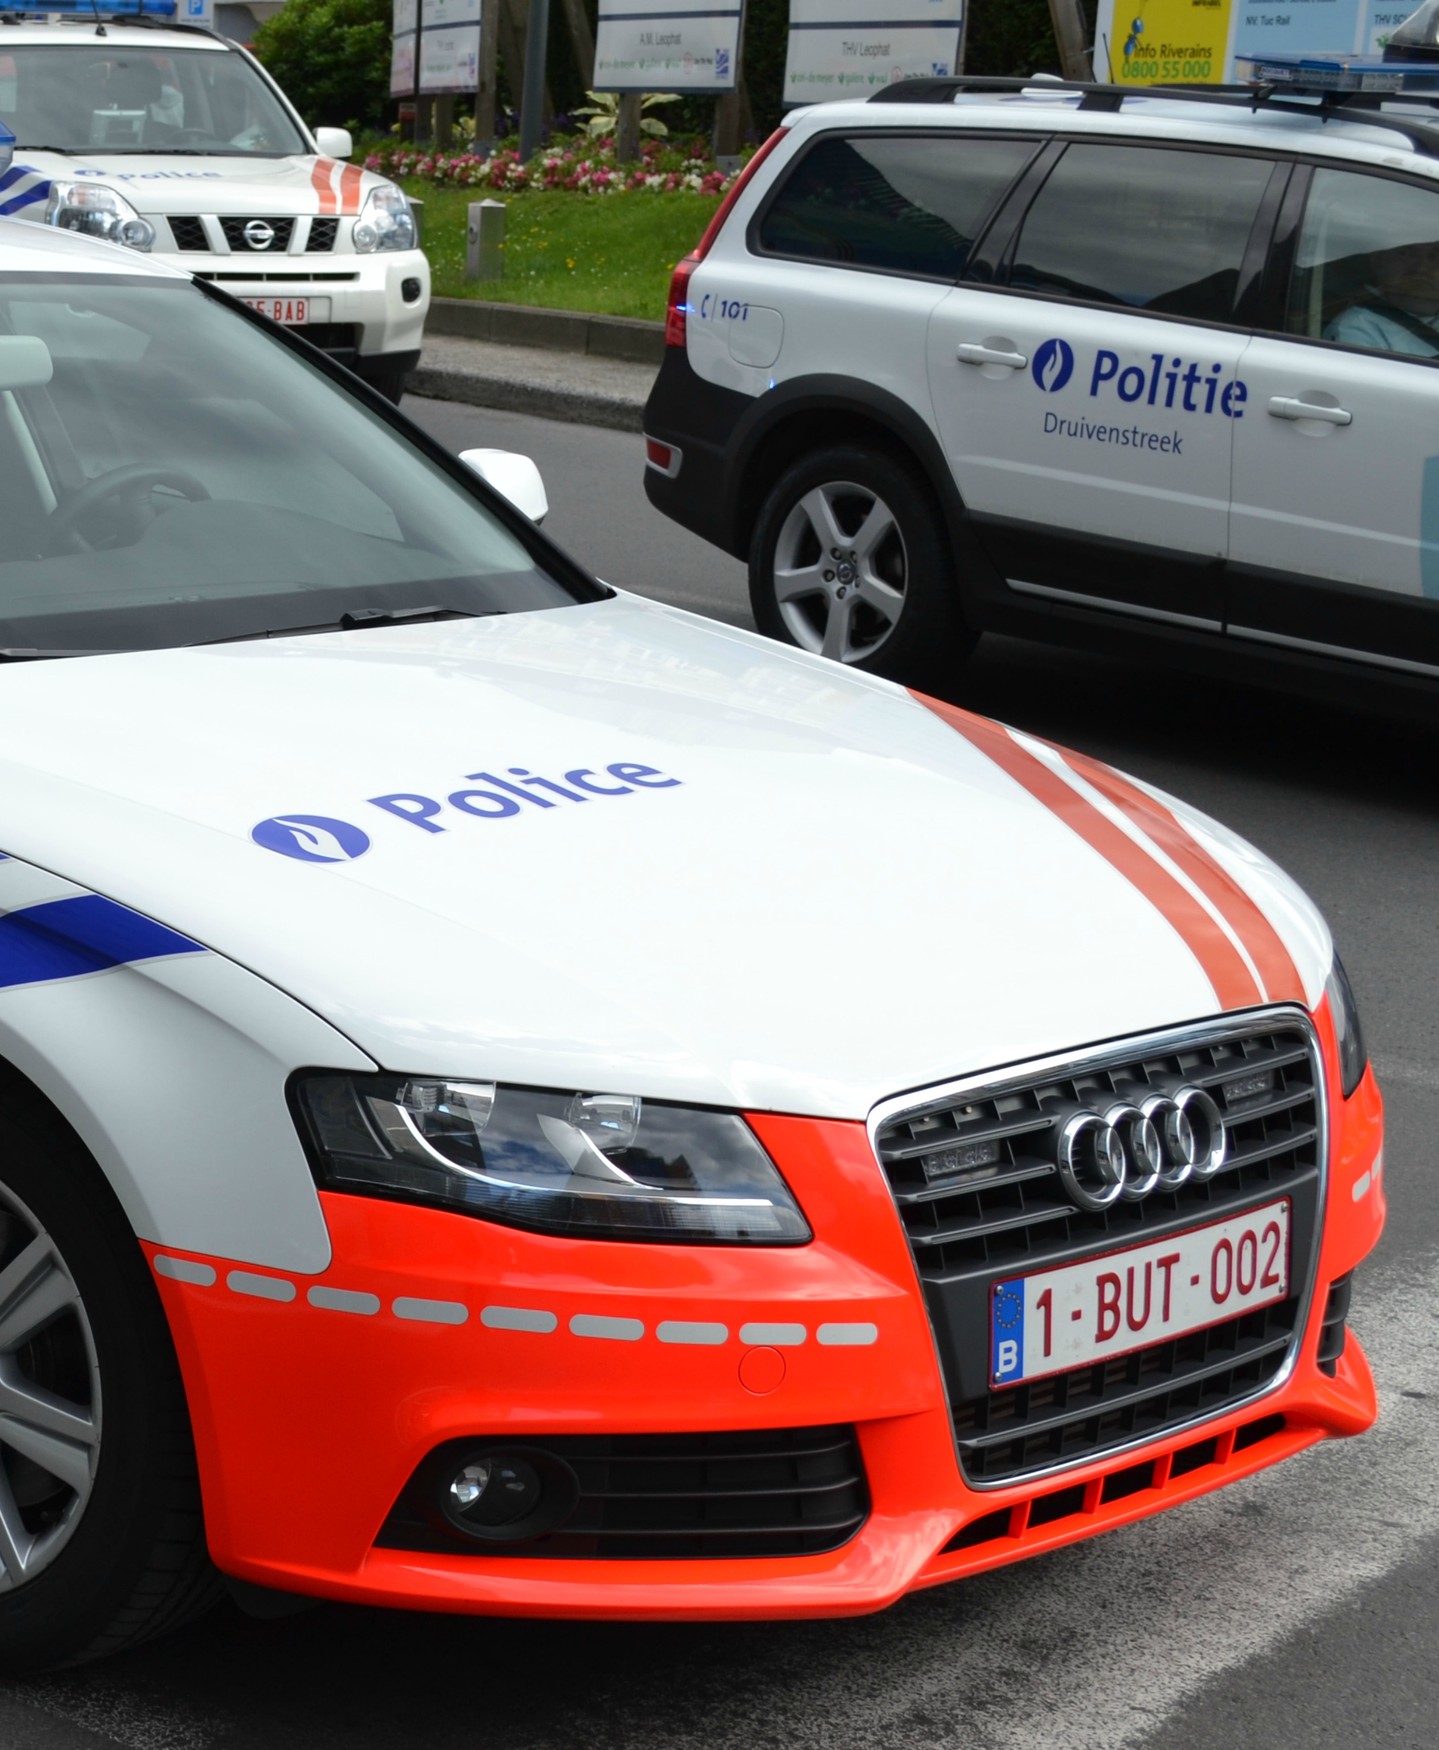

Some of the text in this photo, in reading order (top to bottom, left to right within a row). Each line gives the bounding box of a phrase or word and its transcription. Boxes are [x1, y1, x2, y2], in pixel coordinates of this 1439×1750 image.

[842, 42, 859, 56] THV
[1161, 43, 1212, 59] Riverains
[1122, 60, 1211, 79] 0800 55 000
[116, 170, 223, 182] Police
[720, 300, 751, 322] 101
[1090, 349, 1249, 419] Politie
[1043, 411, 1184, 455] Druivenstreek
[364, 762, 684, 834] Police
[1036, 1220, 1281, 1358] 1-BUT-002
[998, 1339, 1018, 1373] B
